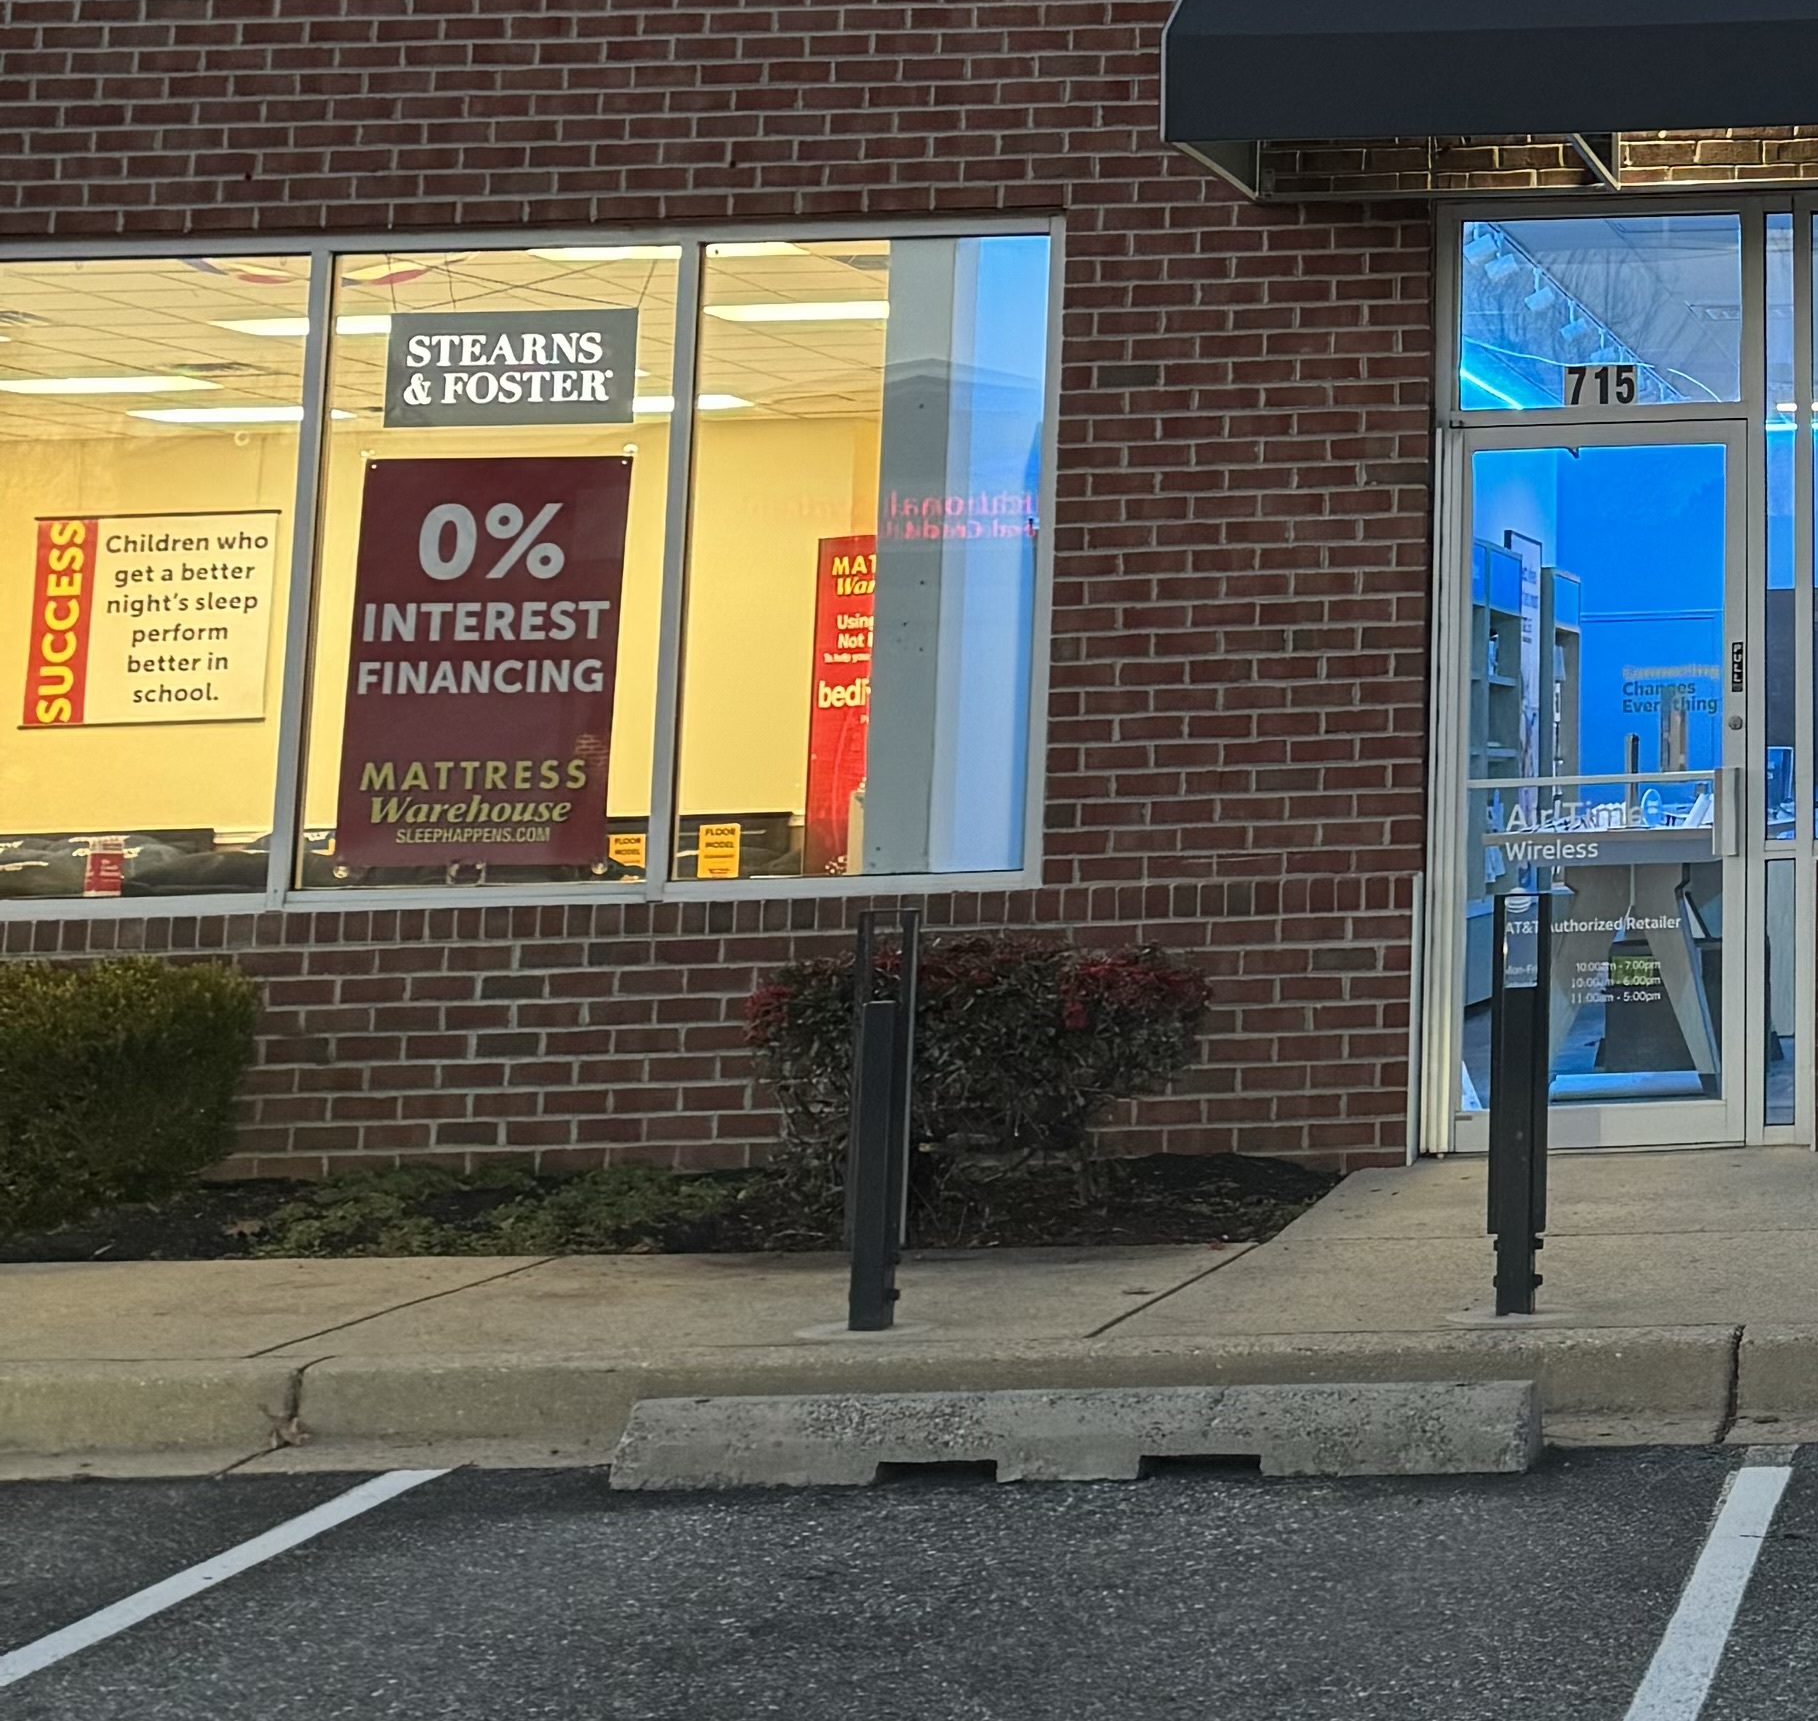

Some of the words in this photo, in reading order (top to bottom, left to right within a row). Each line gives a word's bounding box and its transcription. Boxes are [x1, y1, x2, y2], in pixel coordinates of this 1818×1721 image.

[406, 332, 603, 367] STEARNS
[403, 372, 431, 405] &
[441, 370, 610, 404] FOSTER
[1567, 364, 1635, 405] 715
[105, 533, 209, 553] Children
[217, 531, 269, 550] who
[418, 502, 565, 580] 0%
[114, 565, 155, 588] get
[160, 567, 174, 582] a
[181, 562, 255, 582] better
[106, 592, 189, 618] night's
[195, 591, 258, 614] sleep
[36, 521, 86, 723] SUCCESS
[131, 622, 229, 648] perform
[363, 600, 610, 642] INTEREST
[126, 653, 201, 673] better
[207, 652, 229, 670] in
[357, 658, 605, 695] FINANCING
[1733, 643, 1742, 683] PULL
[132, 682, 219, 703] school.
[1622, 696, 1719, 715] Everthing
[359, 758, 587, 791] MATTRESS
[369, 794, 572, 824] Warehouse
[395, 826, 550, 844] SLEEPHAPPENS.COM
[1505, 838, 1599, 861] Wireless
[1626, 915, 1682, 931] Retailer
